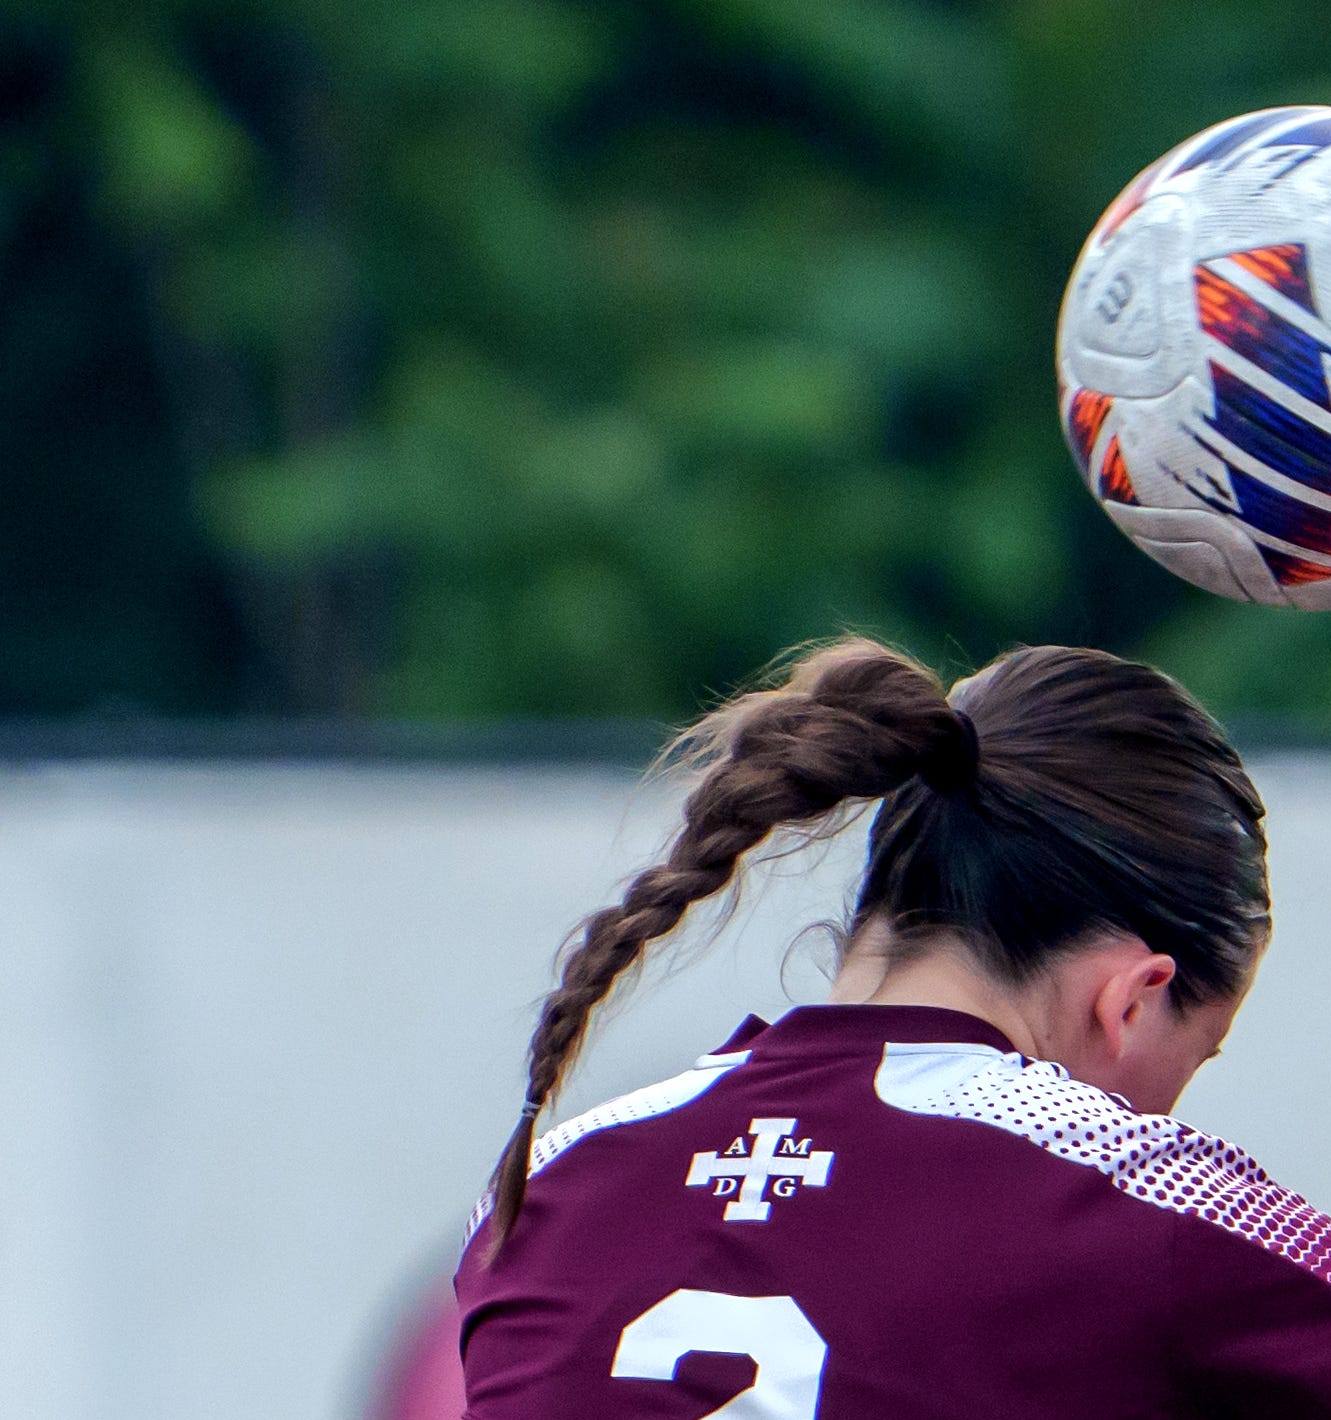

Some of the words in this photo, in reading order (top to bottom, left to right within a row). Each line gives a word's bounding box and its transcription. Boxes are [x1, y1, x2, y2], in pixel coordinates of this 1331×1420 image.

[724, 1136, 747, 1155] A
[779, 1138, 813, 1155] M
[713, 1177, 737, 1196] D
[773, 1177, 796, 1197] G
